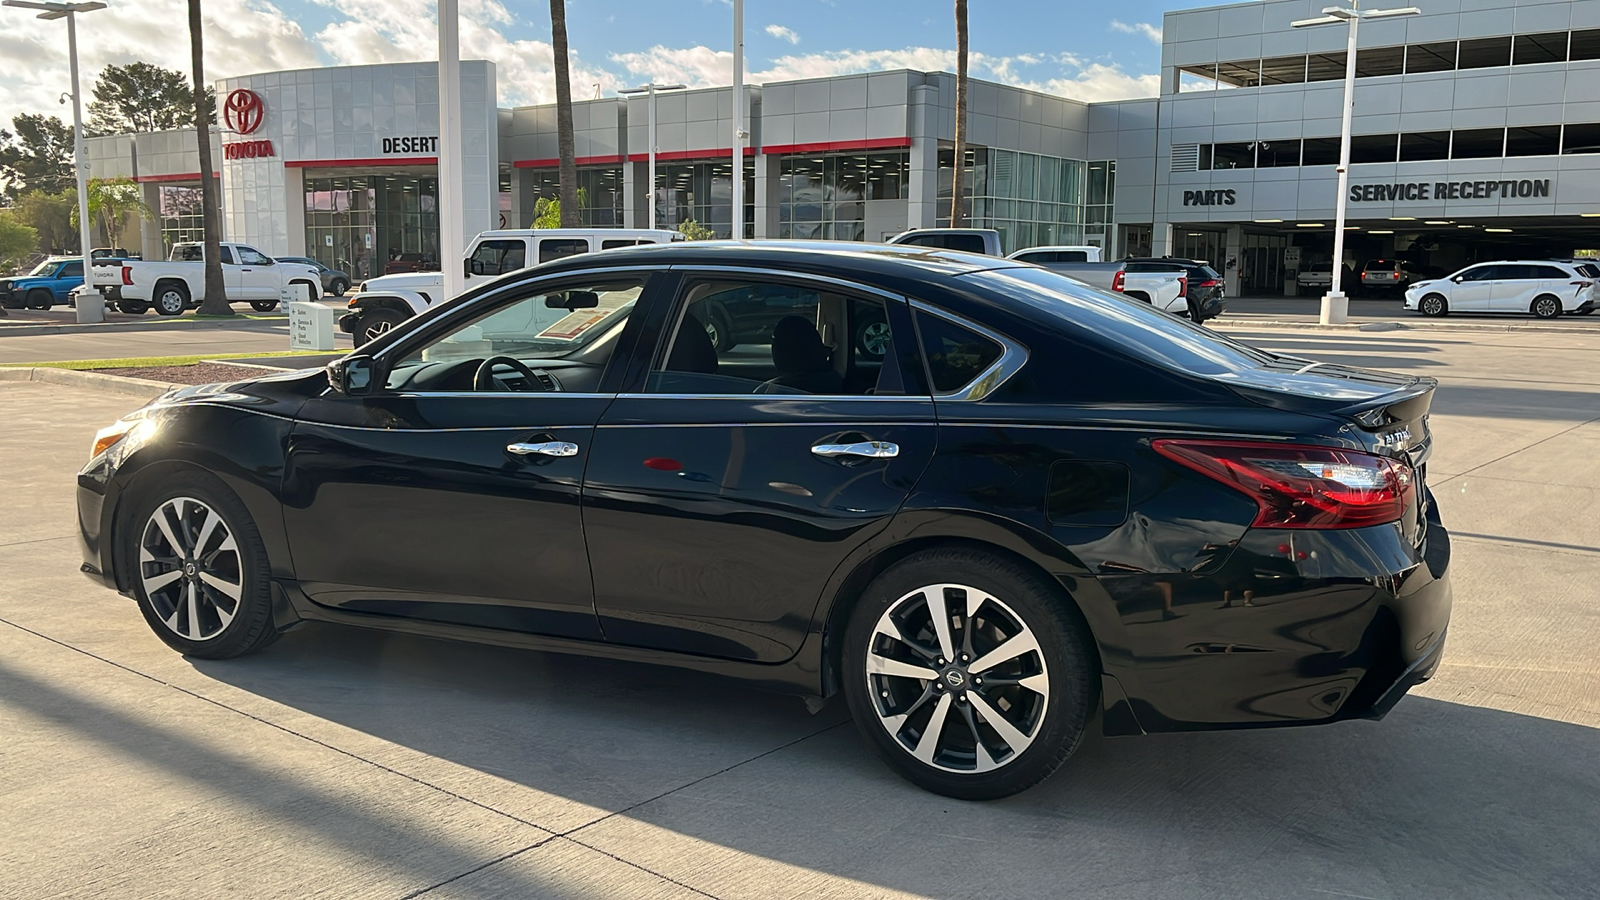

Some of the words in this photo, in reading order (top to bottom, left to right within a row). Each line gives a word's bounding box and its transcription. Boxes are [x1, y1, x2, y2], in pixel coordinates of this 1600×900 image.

[222, 140, 276, 160] TOYOTA
[382, 136, 439, 154] DESERT
[1183, 189, 1236, 206] PARTS
[1350, 182, 1430, 202] SERVICE
[1433, 179, 1550, 200] RECEPTION
